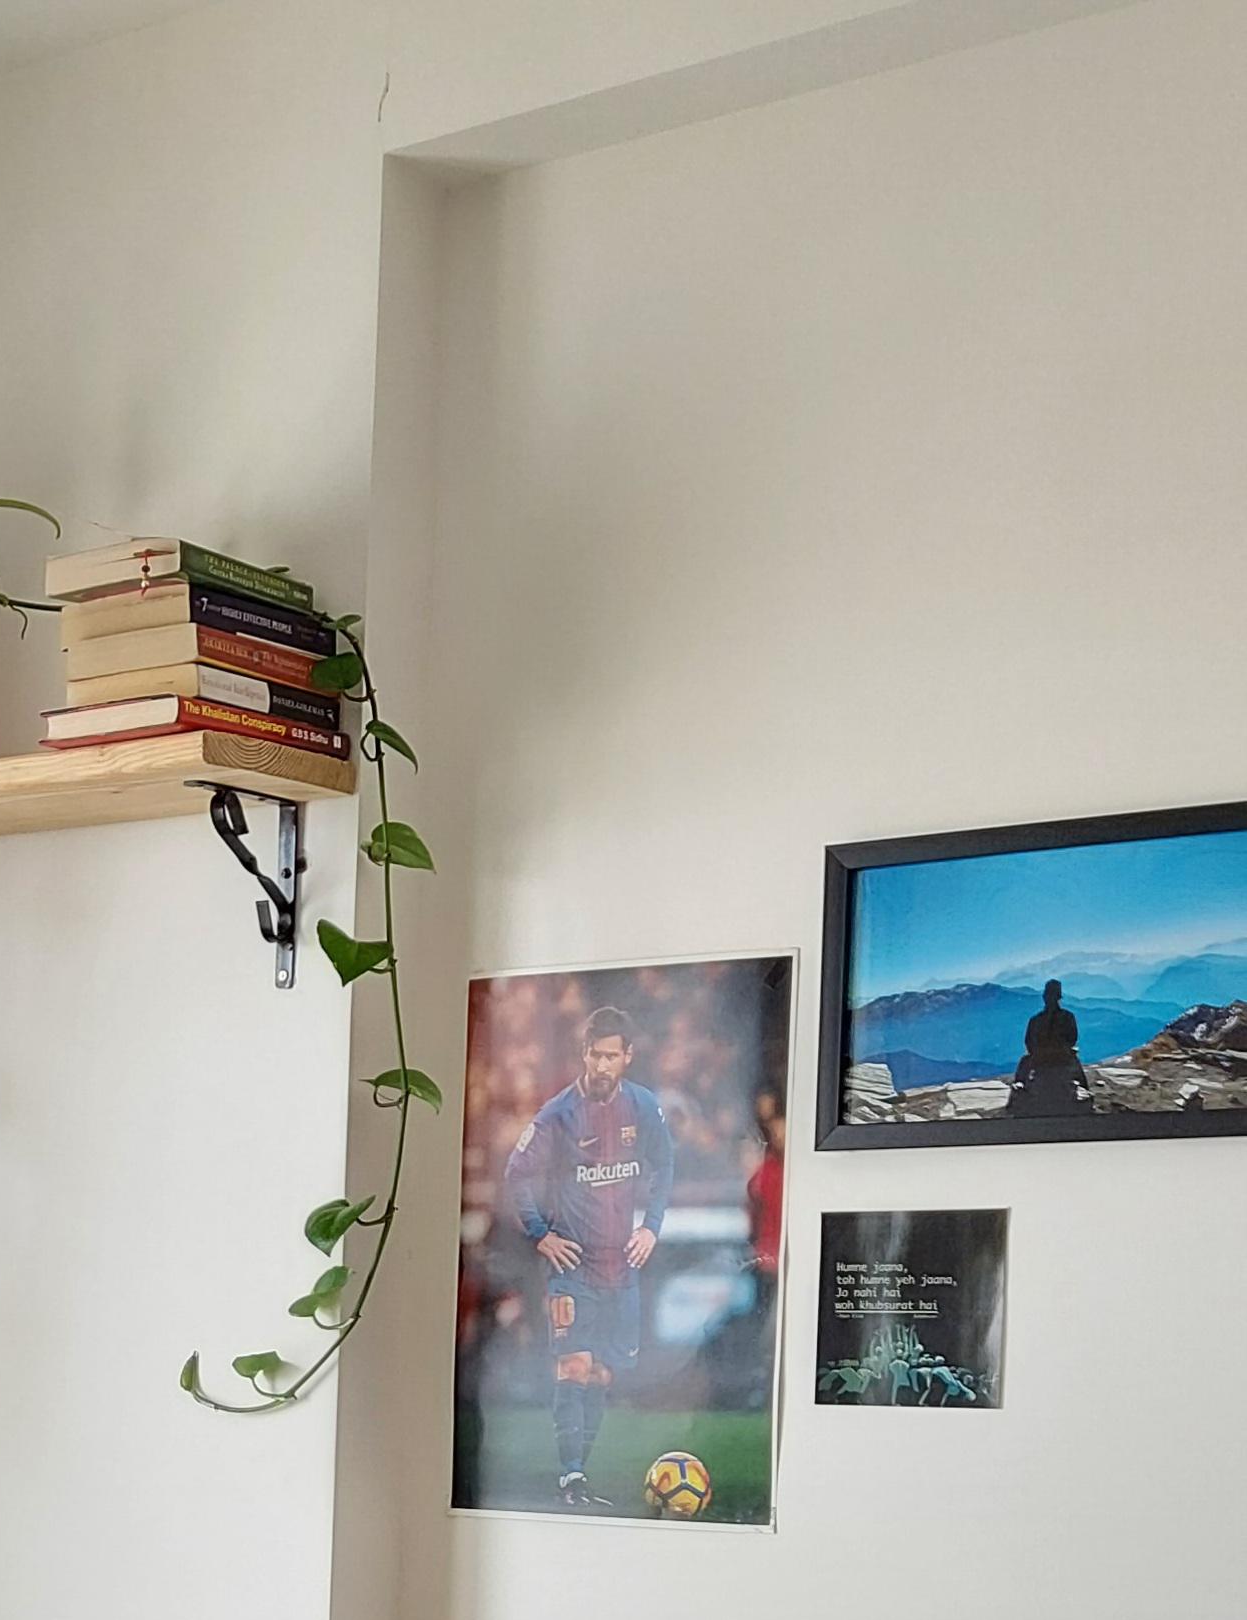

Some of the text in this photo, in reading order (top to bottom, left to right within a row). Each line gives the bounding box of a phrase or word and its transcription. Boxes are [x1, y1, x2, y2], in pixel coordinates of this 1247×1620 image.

[184, 701, 287, 737] The Khalistan Conspiracy
[576, 1161, 640, 1183] Rakuten
[836, 1262, 868, 1272] Humne
[836, 1274, 855, 1285] toh
[860, 1274, 891, 1285] humne
[895, 1274, 915, 1287] yeh
[835, 1287, 902, 1298] Jo nahi hai
[835, 1299, 938, 1310] woh khubsurat hai
